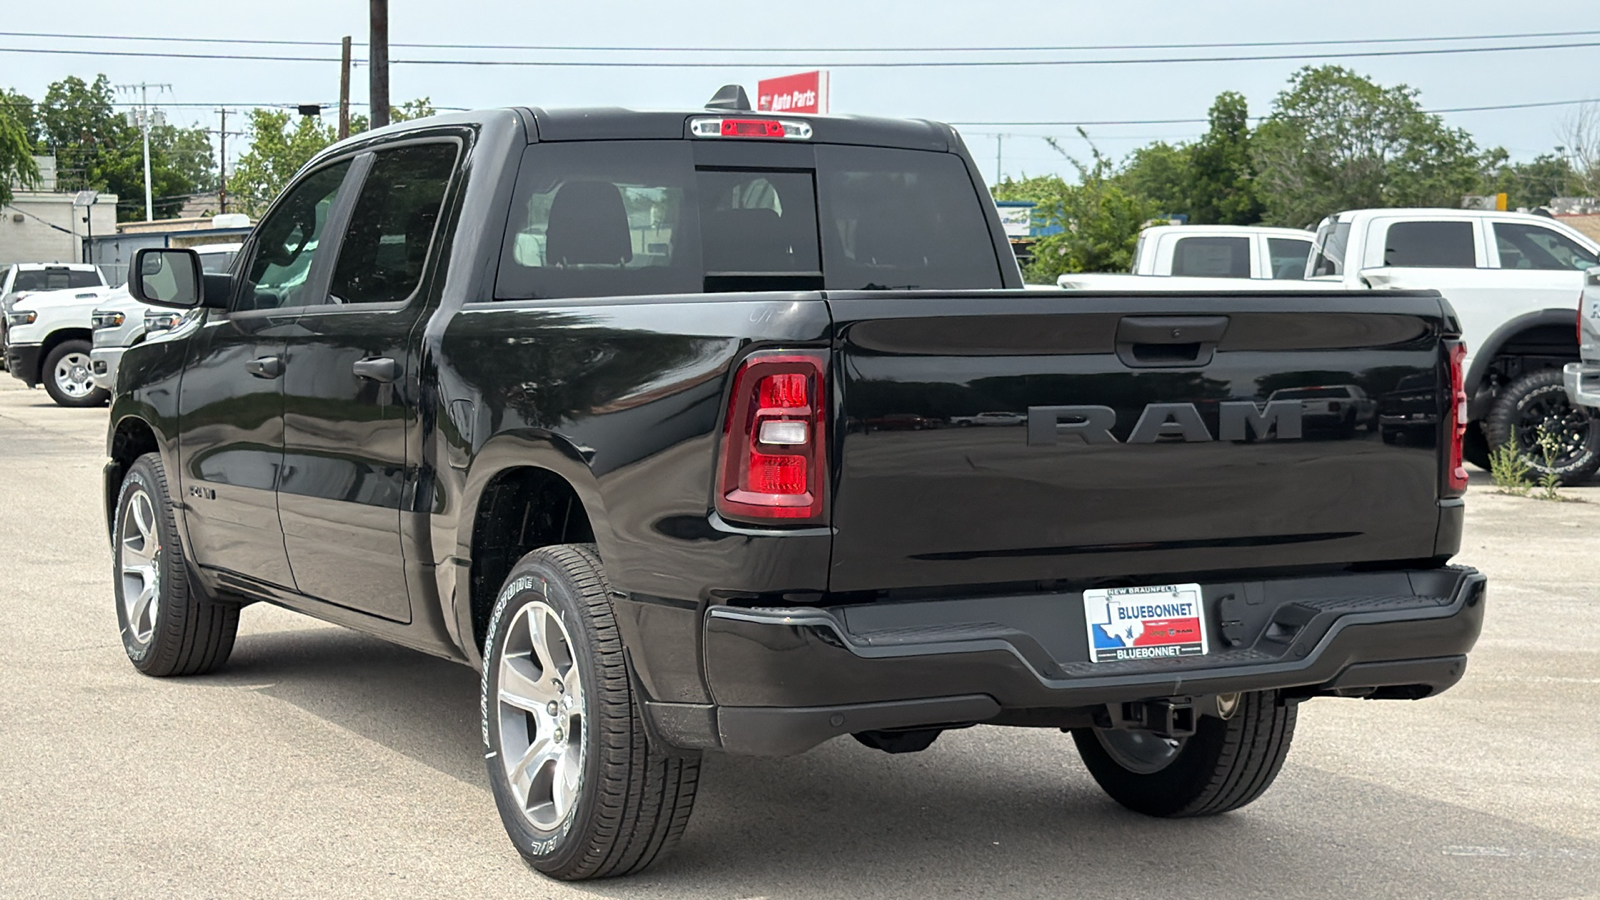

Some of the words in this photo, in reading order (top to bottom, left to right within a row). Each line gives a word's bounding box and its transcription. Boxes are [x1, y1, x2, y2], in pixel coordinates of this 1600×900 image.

[772, 93, 791, 111] Auto
[792, 90, 815, 108] Parts
[1028, 400, 1302, 446] RAM
[1117, 603, 1192, 620] BLUEBONNET
[481, 576, 534, 749] BRIDGESTONE
[1116, 646, 1181, 660] BLUEBONNET
